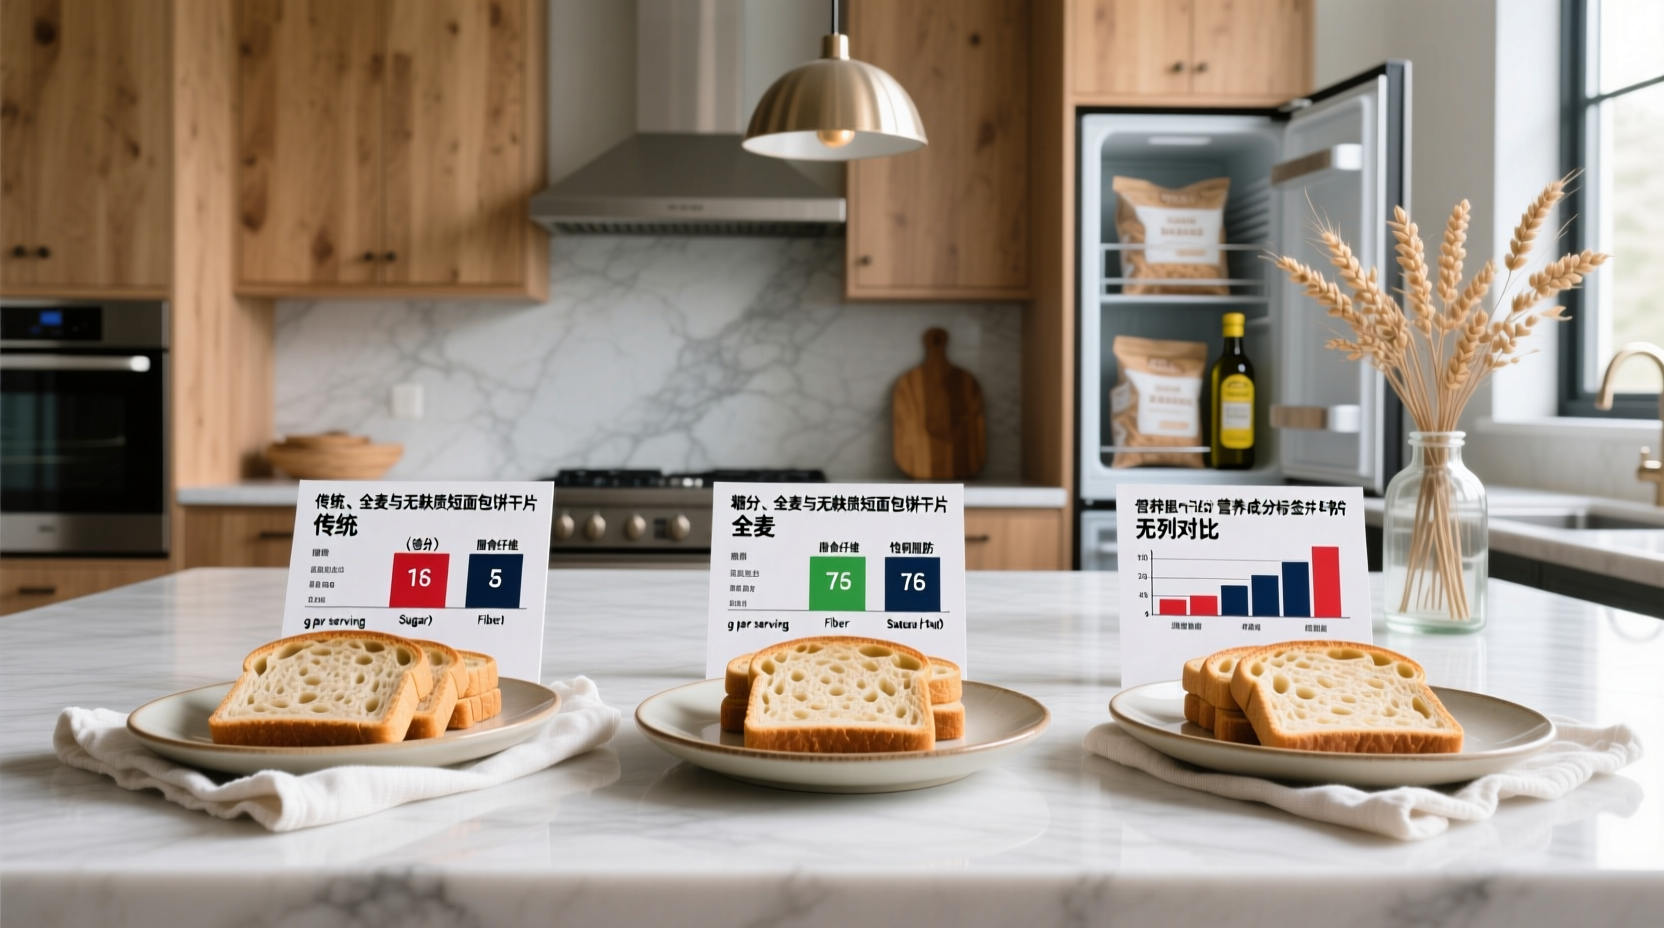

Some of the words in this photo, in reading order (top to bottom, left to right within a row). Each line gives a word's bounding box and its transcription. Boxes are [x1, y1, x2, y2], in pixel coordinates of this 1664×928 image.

[313, 513, 358, 537] 传统
[731, 514, 776, 538] 全麦
[1136, 516, 1219, 540] 无列对比
[408, 568, 432, 587] 16
[488, 568, 502, 588] 5
[900, 572, 926, 592] 76
